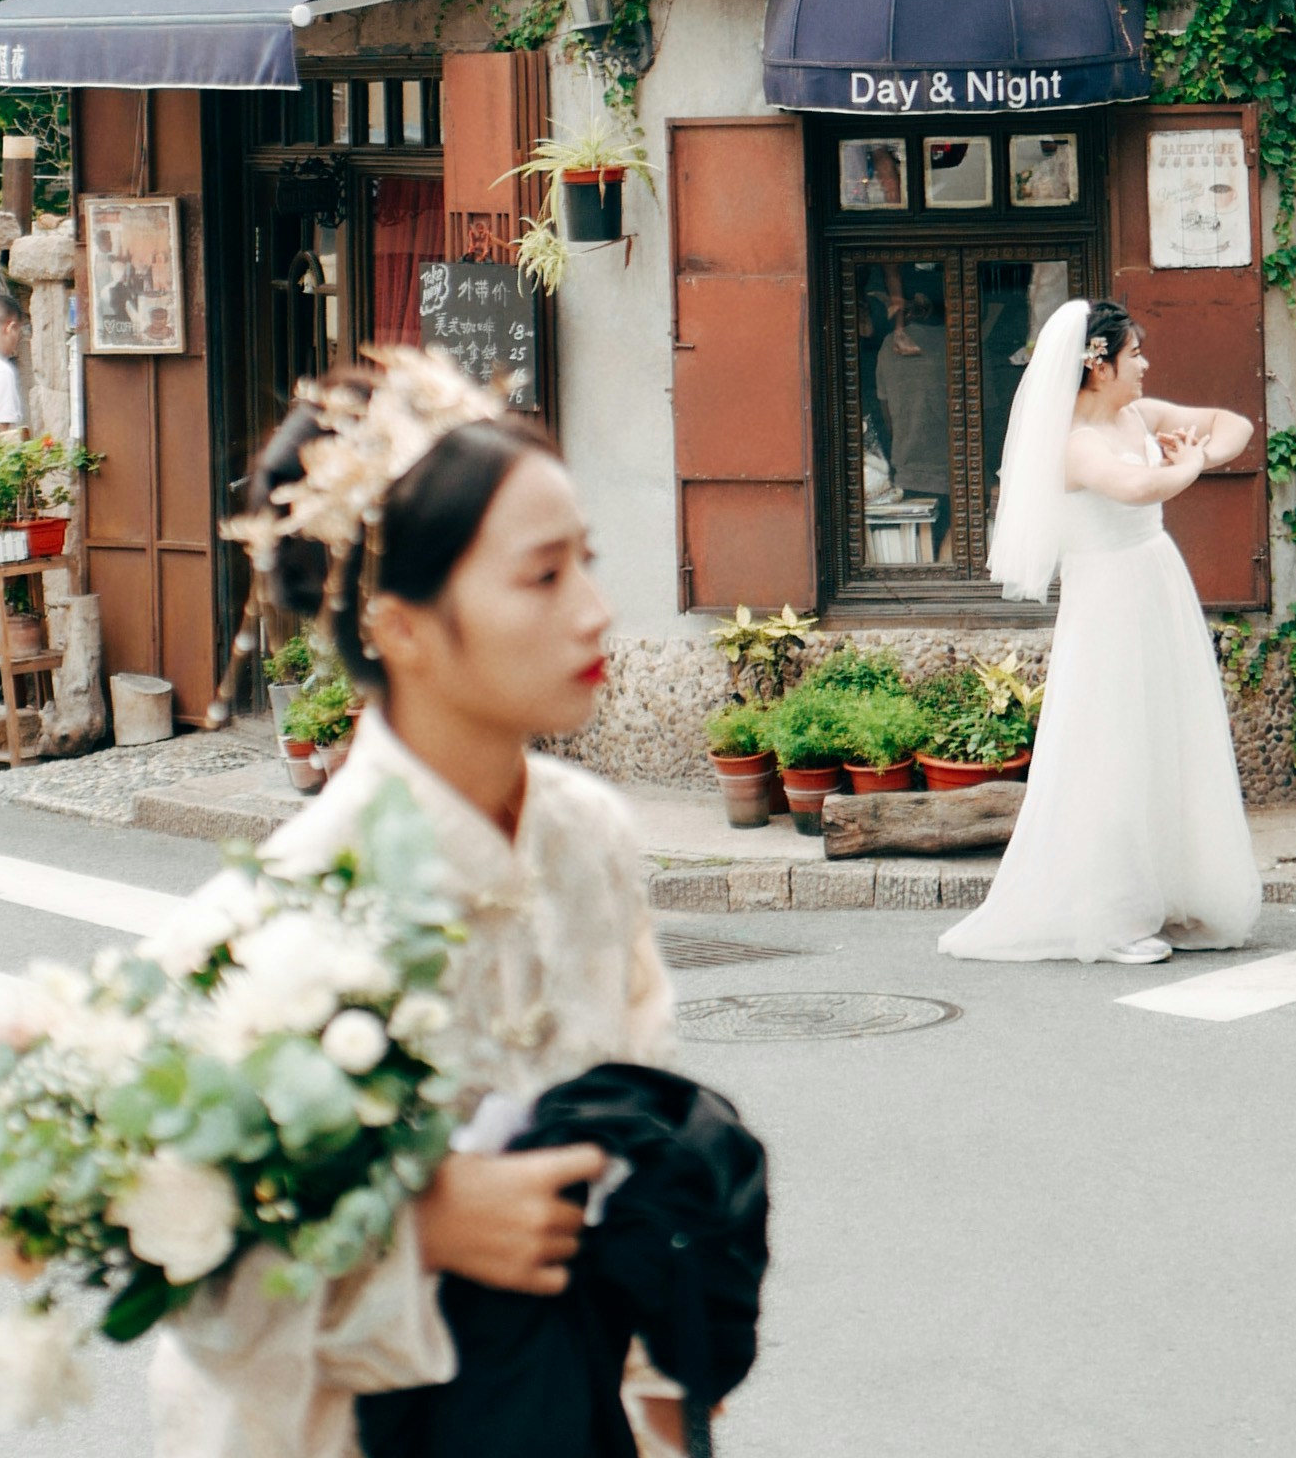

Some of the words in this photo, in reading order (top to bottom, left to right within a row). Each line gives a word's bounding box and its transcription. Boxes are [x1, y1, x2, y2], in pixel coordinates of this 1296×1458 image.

[850, 71, 919, 111] Day
[928, 71, 956, 103] &
[966, 69, 1062, 109] Night
[1161, 143, 1204, 155] BAKERY
[434, 312, 496, 343] 美式咖啡
[509, 346, 527, 361] 25
